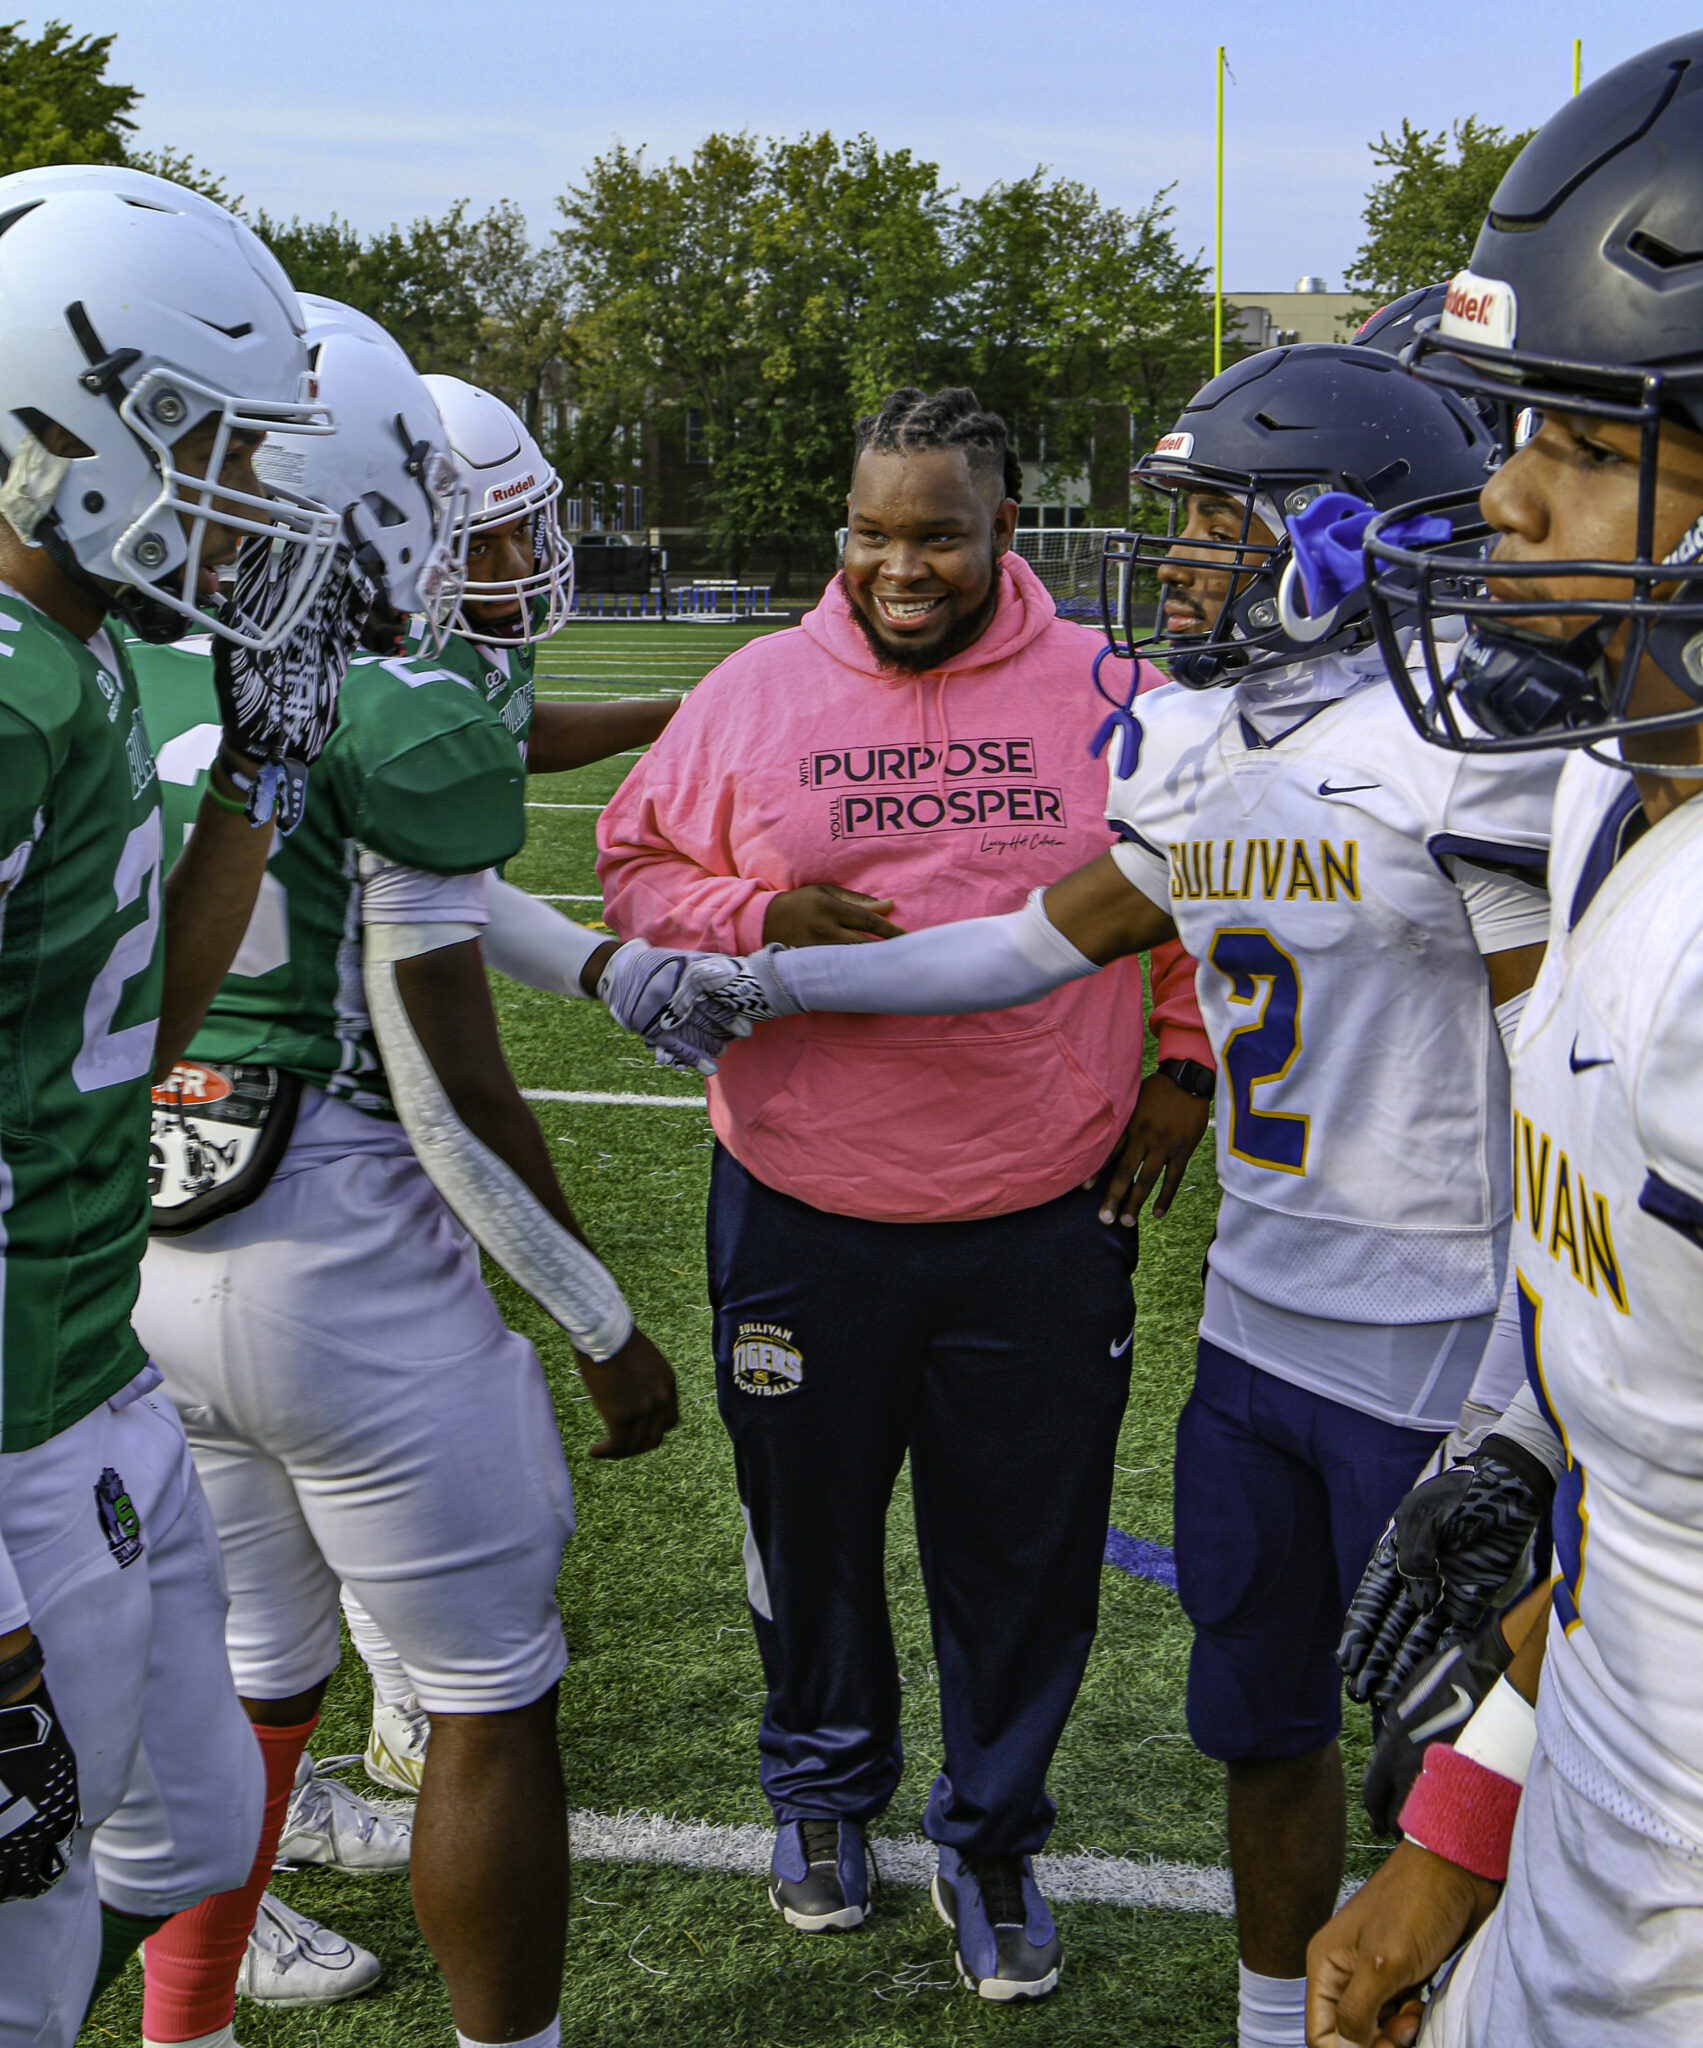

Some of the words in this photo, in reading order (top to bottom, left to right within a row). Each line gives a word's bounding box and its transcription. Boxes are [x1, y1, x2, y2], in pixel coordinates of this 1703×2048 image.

[492, 474, 536, 503] Riddell
[533, 514, 546, 559] Riddell
[800, 757, 809, 787] WITH
[814, 741, 1034, 785] PURPOSE
[845, 788, 1063, 833] PROSPER
[1168, 839, 1362, 901] SULLIVAN
[1206, 927, 1310, 1177] 2
[739, 1323, 793, 1342] SULLIVAN
[733, 1342, 803, 1383] TIGERS
[734, 1376, 800, 1396] FOOTBALL
